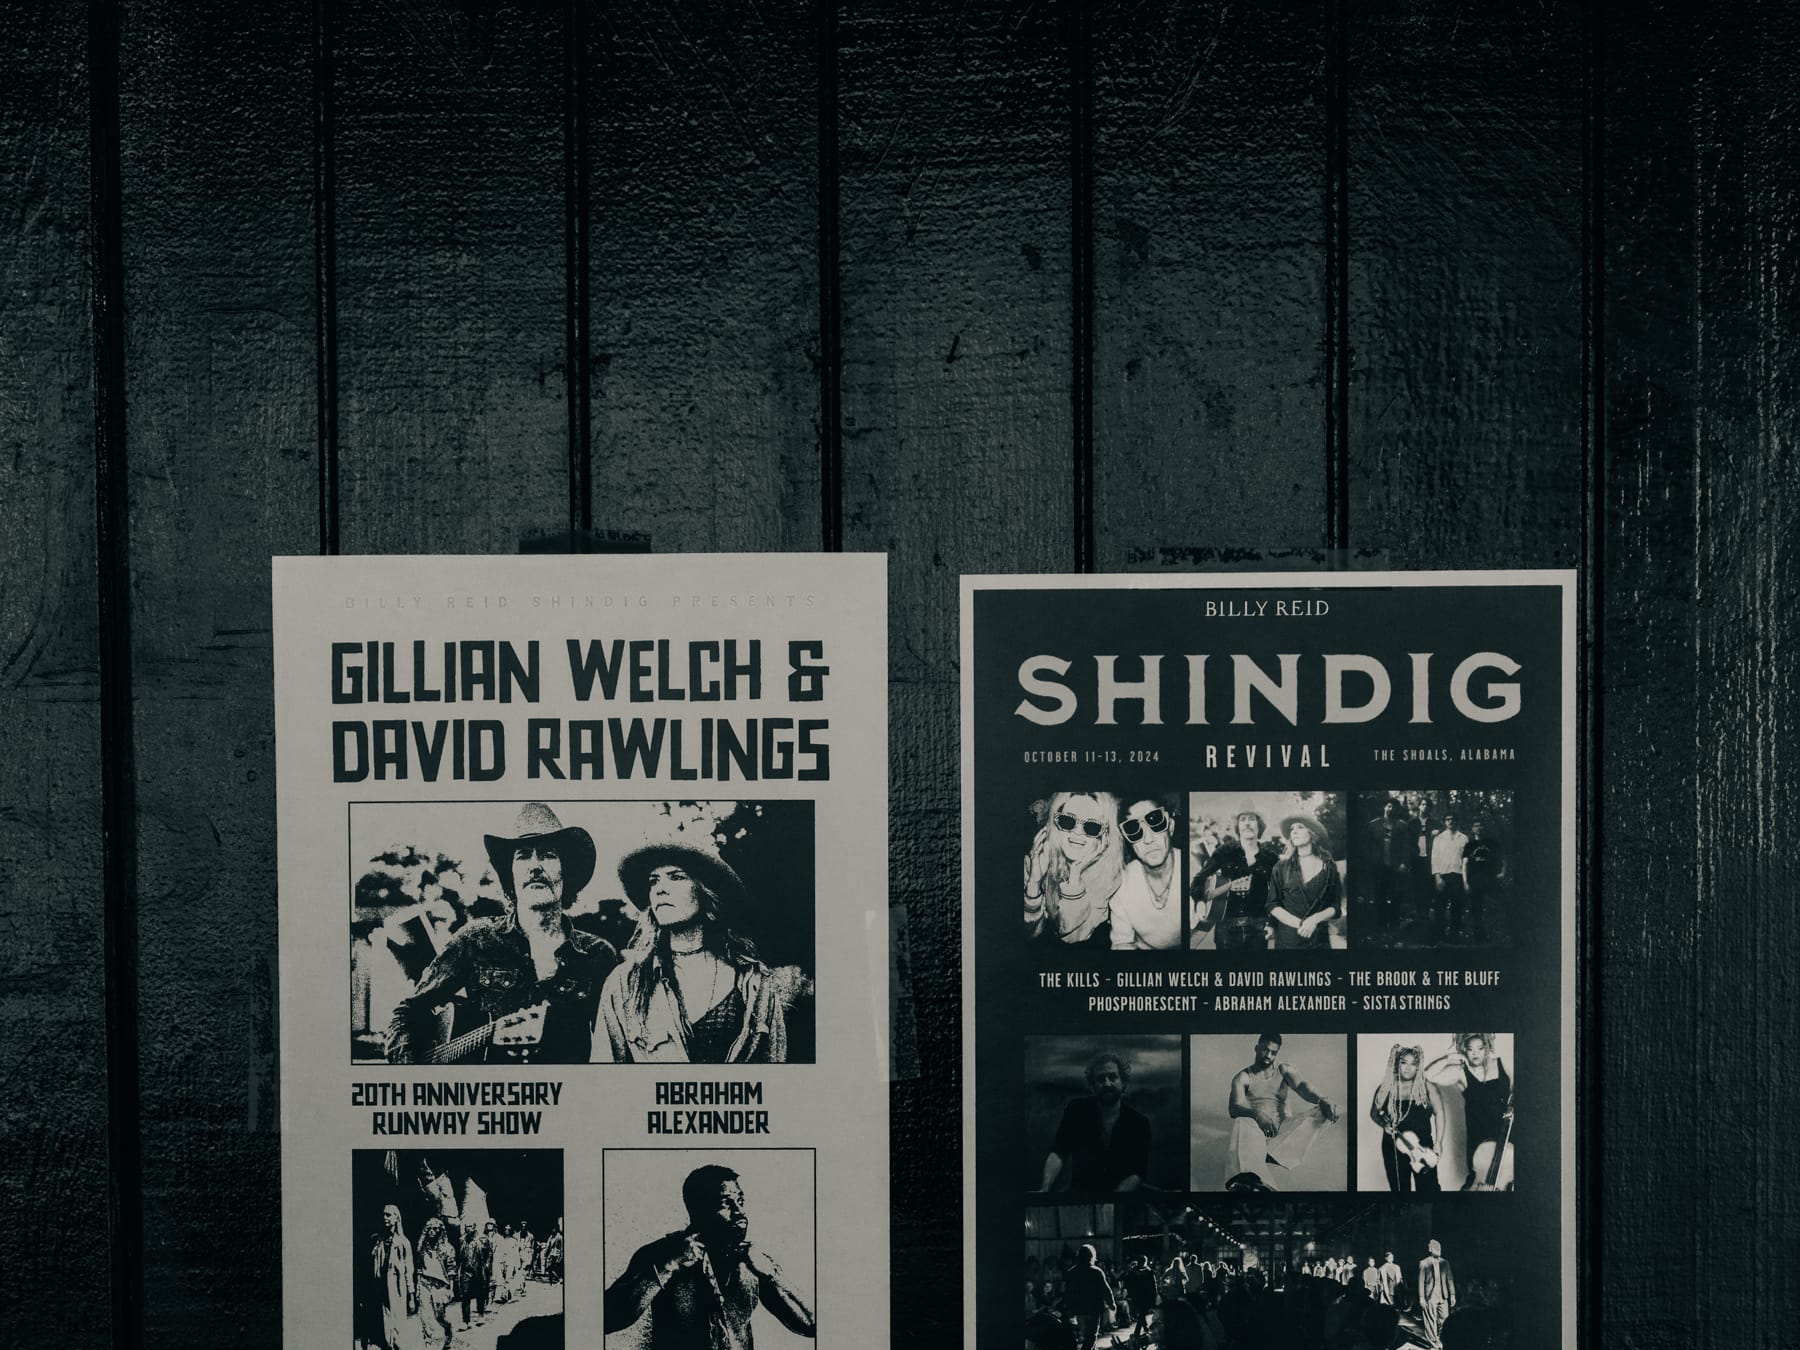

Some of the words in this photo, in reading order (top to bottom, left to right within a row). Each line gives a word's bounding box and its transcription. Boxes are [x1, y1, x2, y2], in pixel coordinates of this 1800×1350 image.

[446, 596, 508, 609] REID
[531, 595, 648, 609] SHINDIG
[1204, 600, 1268, 617] BILLY
[1275, 599, 1329, 617] REID
[331, 639, 540, 705] GILLIAN
[565, 638, 762, 704] WELCH
[787, 639, 830, 703] &
[1013, 651, 1523, 727] SHINDIG
[331, 718, 506, 784] DAVID
[527, 717, 831, 782] RAWLINGS
[1024, 750, 1078, 764] OCTOBER
[1085, 750, 1122, 764] 11-13,
[1129, 750, 1159, 763] 2024
[1205, 744, 1330, 769] REVIVAL
[1373, 749, 1395, 762] THE
[1402, 748, 1453, 762] SHOALS,
[1460, 748, 1515, 761] ALABAMA
[1038, 972, 1062, 988] THE
[1066, 972, 1100, 988] KILLS
[1116, 971, 1163, 988] GILLIAN
[1168, 971, 1209, 988] WELCH
[1214, 971, 1224, 987] &
[1228, 971, 1264, 987] DAVID
[1269, 971, 1332, 987] RAWLINGS
[1348, 970, 1372, 987] THE
[1376, 970, 1417, 987] BROOK
[1422, 970, 1432, 986] &
[1436, 970, 1460, 986] THE
[1464, 970, 1501, 986] BLUFF
[1088, 995, 1198, 1012] PHOSPHORESCENT
[1214, 995, 1272, 1011] ABRAHAM
[1277, 995, 1346, 1011] ALEXANDER
[351, 1082, 407, 1107] 20TH
[412, 1081, 564, 1107] ANNIVERSARY
[655, 1081, 763, 1106] ABRAHAM
[372, 1111, 471, 1136] RUNWAY
[477, 1110, 543, 1136] SHOW
[647, 1110, 771, 1135] ALEXANDER
